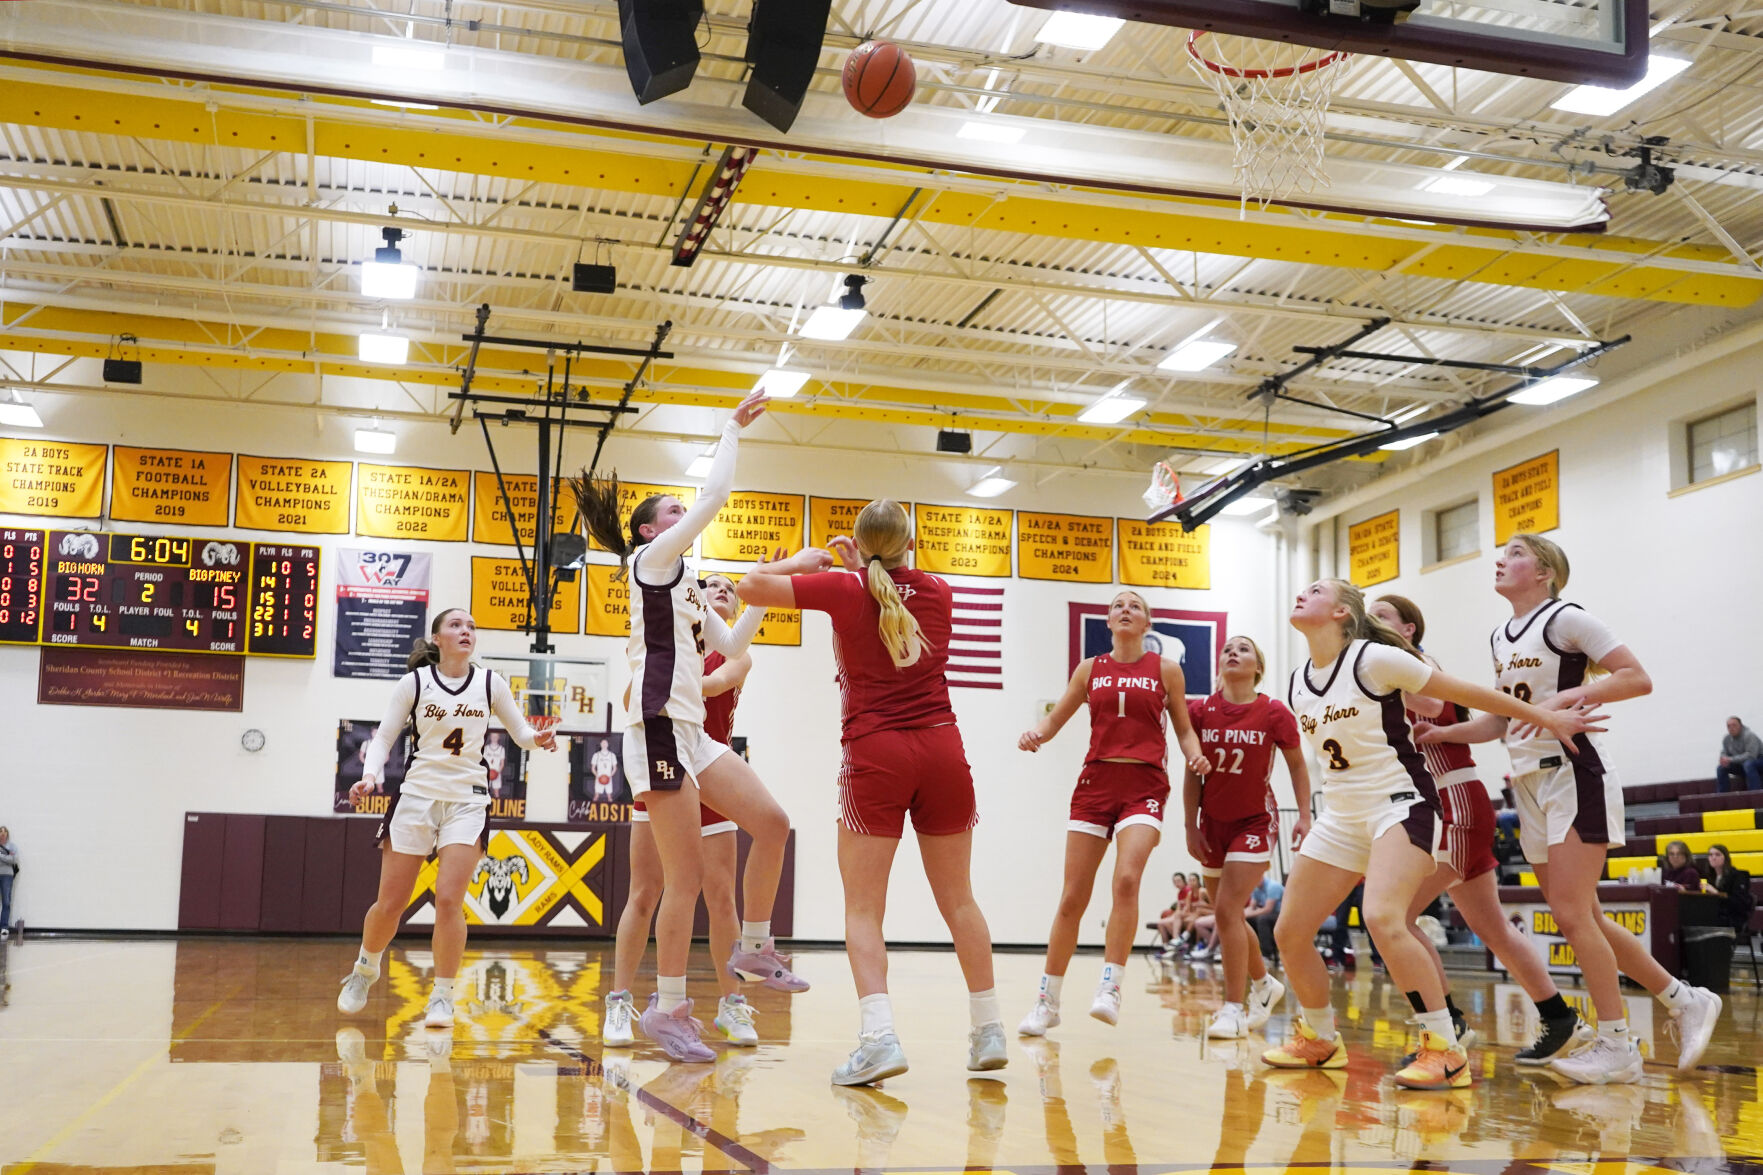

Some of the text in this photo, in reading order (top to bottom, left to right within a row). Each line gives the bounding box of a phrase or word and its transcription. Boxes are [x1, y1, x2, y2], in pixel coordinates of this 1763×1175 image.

[23, 447, 70, 460] 2A BOYS
[7, 462, 84, 477] STATE TRACK
[139, 456, 205, 470] STATE 1A
[135, 471, 208, 486] FOOTBALL
[260, 464, 327, 479] STATE 2A
[12, 478, 76, 493] CHAMPIONS
[250, 479, 338, 495] VOLLEYBALL
[370, 472, 458, 488] STATE 1A/2A
[27, 496, 59, 508] 2019
[131, 487, 210, 502] CHAMPIONS
[363, 487, 464, 503] THESPIAN/DRAMA
[155, 505, 185, 517] 2019
[255, 496, 331, 511] CHAMPIONS
[375, 504, 450, 518] CHAMPIONS
[733, 499, 791, 512] BOYS STATE
[278, 514, 307, 525] 2021
[396, 521, 428, 532] 2022
[713, 514, 796, 527] RACK AND FIELD
[926, 511, 1003, 526] STATE 1A/2A
[1028, 519, 1103, 534] 1A/2A STATE
[3, 531, 37, 542] FLS PTS
[727, 529, 780, 541] CHAMPIONS
[921, 525, 1007, 540] THESPIAN/DRAMA
[1146, 527, 1167, 537] BOYS
[918, 539, 1010, 555] STATE CHAMPIONS
[1020, 533, 1058, 544] SPEECH
[1074, 536, 1111, 548] DEBATE
[1127, 540, 1202, 554] TRACK AND FIELD
[3, 544, 40, 560] 0 0
[130, 537, 188, 563] 6:04
[259, 547, 313, 558] PLYR FLS PTS
[739, 545, 768, 555] 2023
[1033, 548, 1097, 562] CHAMPIONS
[7, 561, 39, 576] 1 5
[271, 561, 316, 577] 1 0 5
[362, 552, 412, 579] 307
[951, 557, 978, 568] 2023
[1140, 555, 1189, 567] CHAMPIONS
[134, 571, 164, 582] PERIOD
[1052, 564, 1079, 575] 2024
[1152, 570, 1177, 580] 2024
[1, 576, 38, 593] 0 8
[67, 576, 99, 602] 32
[260, 575, 315, 591] 14 1 1
[0, 592, 37, 608] 0 3
[141, 583, 155, 603] 2
[213, 585, 235, 609] 15
[259, 591, 314, 608] 15 1 0
[0, 609, 36, 625] 0 12
[53, 602, 237, 620] FOULS T.O.L. PLAYER FOUL T.O.L. FOULS
[253, 605, 313, 621] 22 1 4
[762, 612, 800, 623] MPIONS
[69, 613, 234, 638] 1 4 4 1
[254, 622, 312, 639] 31 1 2
[51, 633, 236, 651] SCORE MATCH SCORE
[1507, 653, 1543, 671] Horn
[46, 664, 79, 674] Sheridan
[80, 665, 107, 677] County
[109, 667, 133, 676] School
[135, 668, 161, 677] District
[212, 672, 239, 681] District
[1092, 676, 1159, 692] BIG PINEY
[424, 703, 485, 721] Big Horn
[1117, 691, 1126, 718] 1
[1300, 704, 1359, 735] Big Horn
[442, 727, 465, 757] 4
[1201, 728, 1267, 745] BIG PINEY
[1214, 747, 1245, 775] 22
[1322, 738, 1350, 770] 3
[526, 832, 565, 874] LADY RAMS
[534, 891, 558, 914] RAMS
[1549, 944, 1579, 966] LAD
